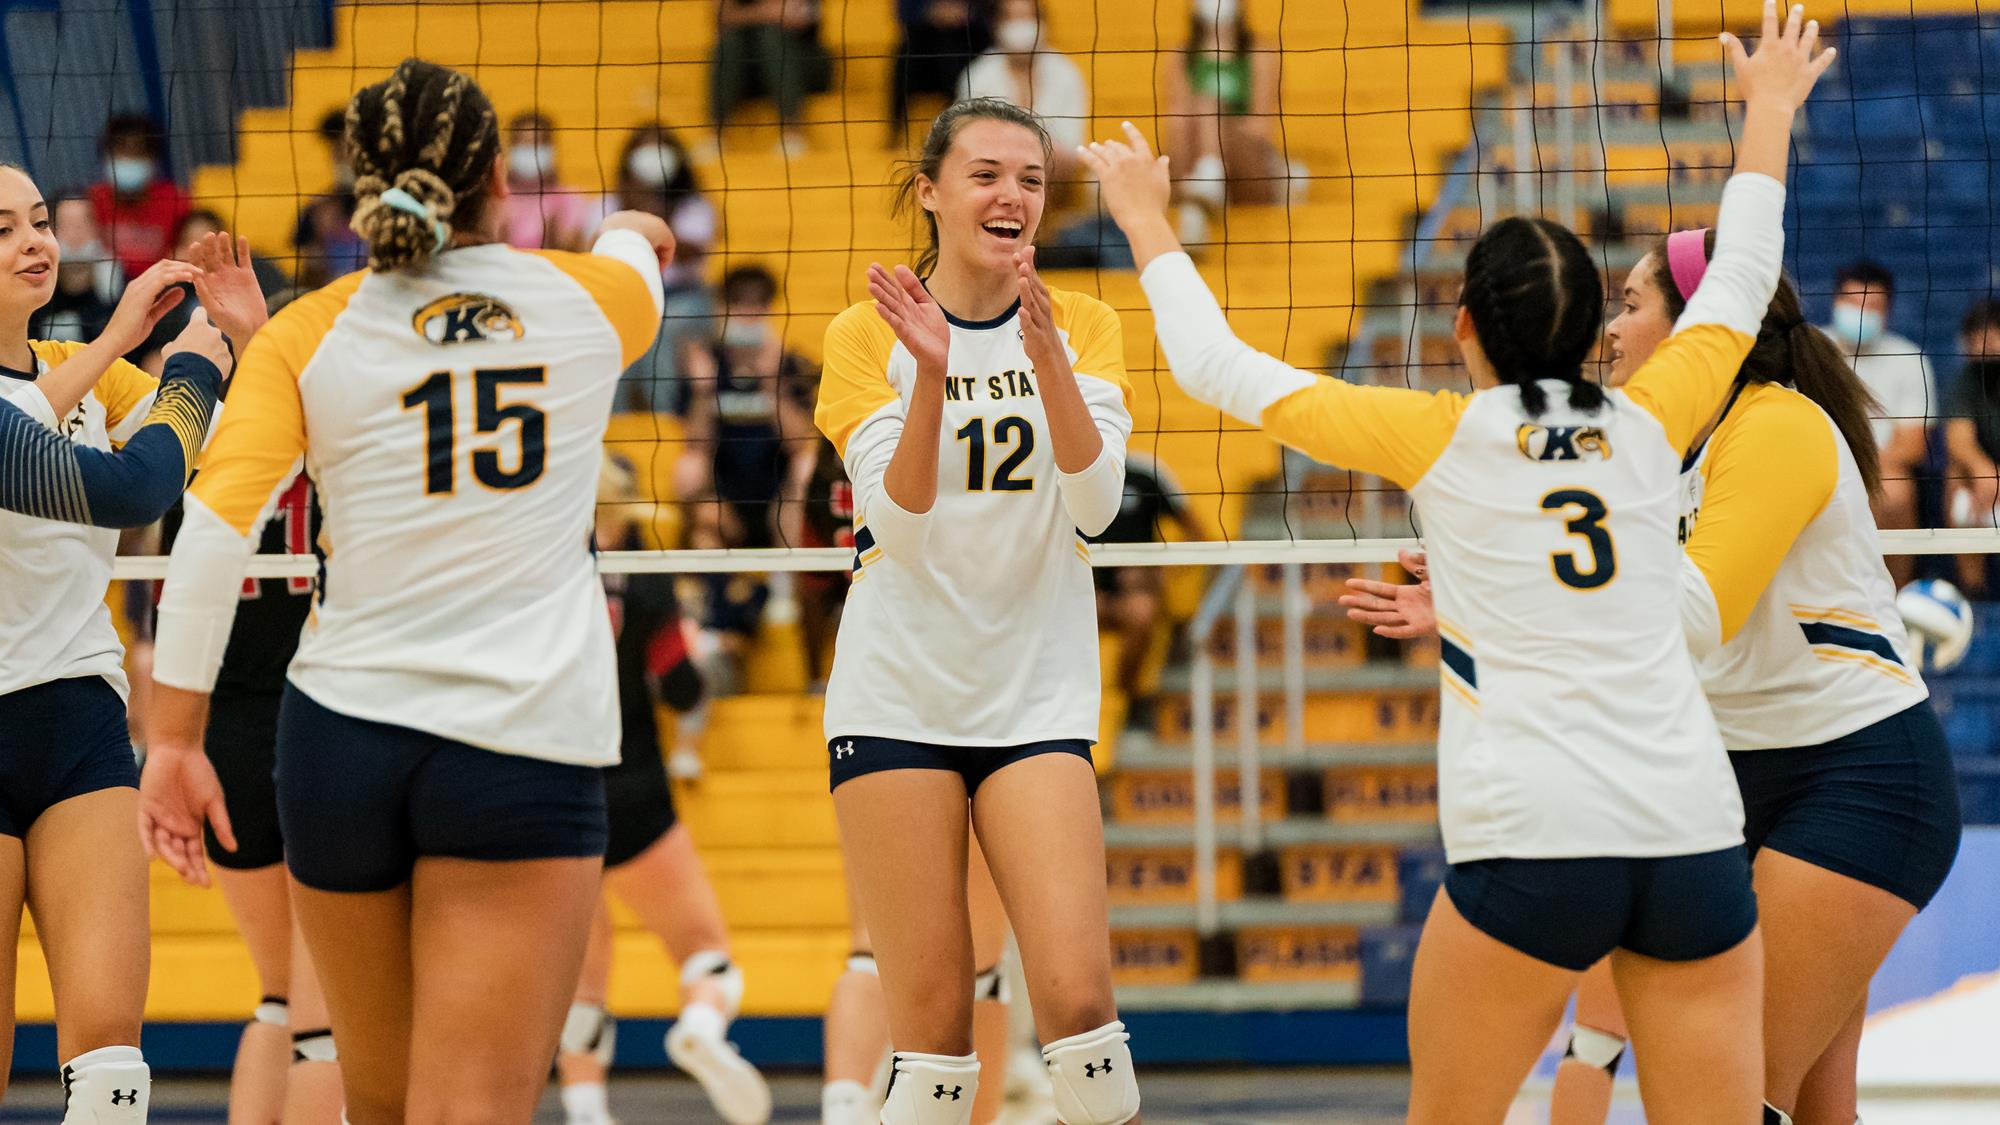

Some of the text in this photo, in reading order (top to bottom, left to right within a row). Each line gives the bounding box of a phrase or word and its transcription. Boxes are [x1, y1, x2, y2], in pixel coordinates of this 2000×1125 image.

[988, 369, 1036, 400] STA
[400, 366, 548, 496] 15
[955, 414, 1036, 493] 12
[1538, 486, 1618, 592] 3
